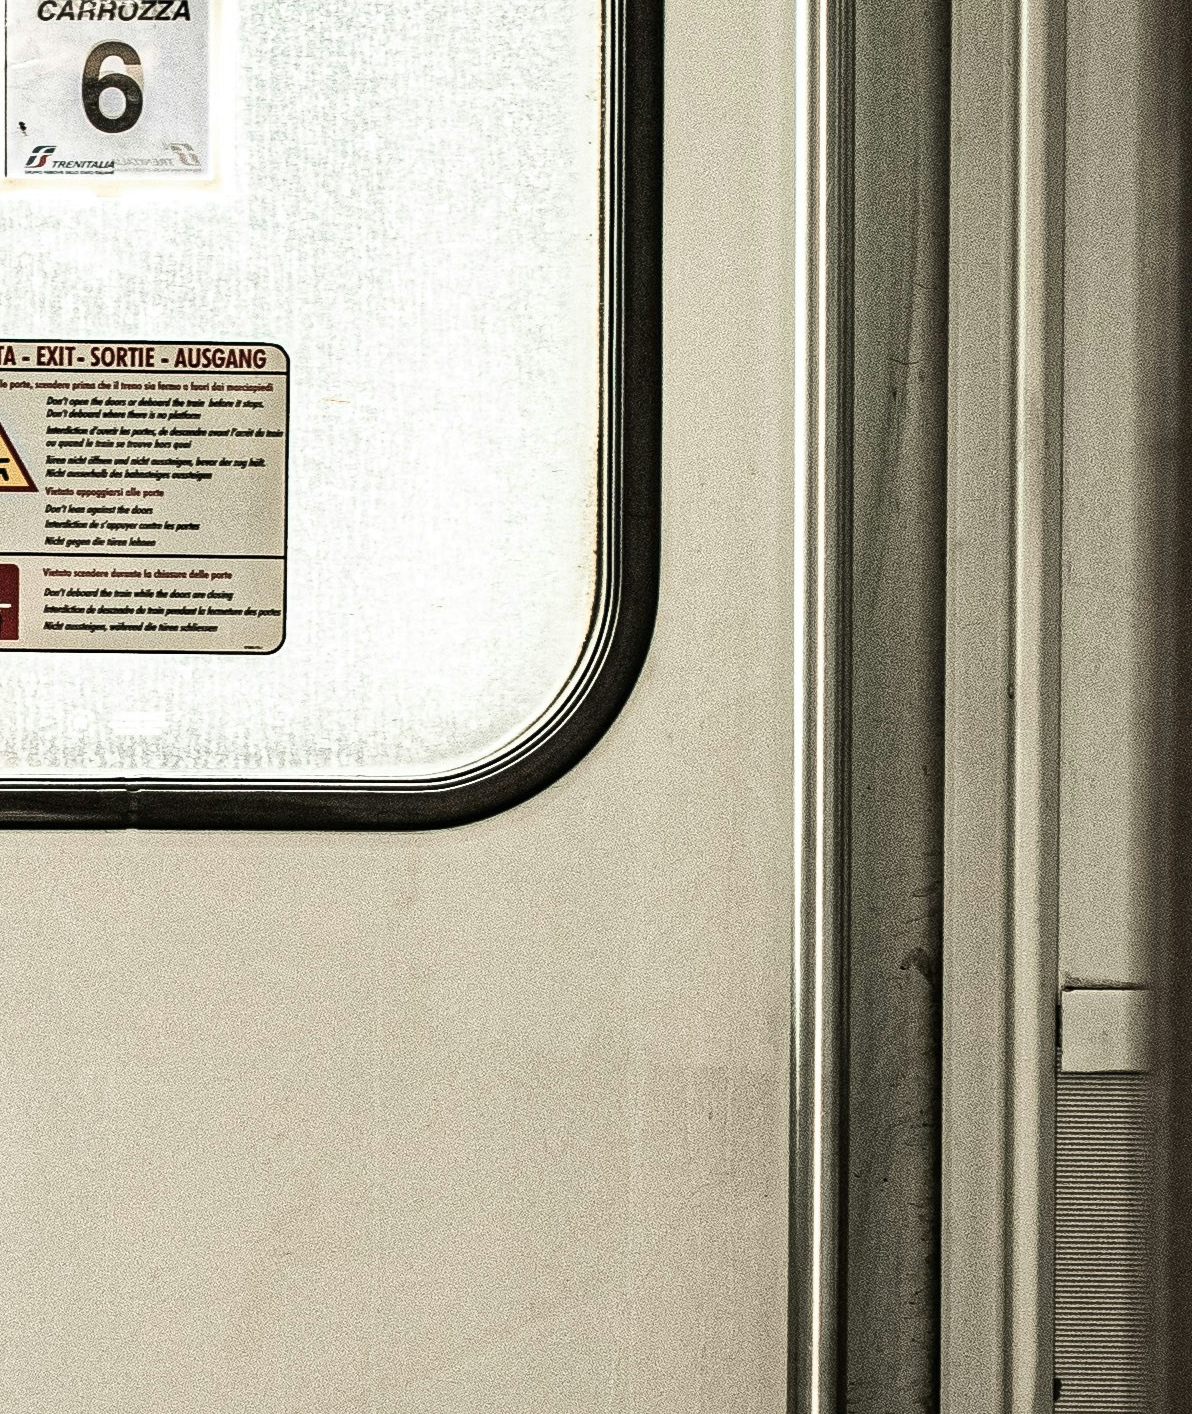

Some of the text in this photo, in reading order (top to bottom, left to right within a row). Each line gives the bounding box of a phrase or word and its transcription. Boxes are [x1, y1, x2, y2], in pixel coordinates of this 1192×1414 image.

[37, 0, 191, 21] CARROZZA
[81, 40, 144, 134] 6
[51, 160, 116, 169] TRENITALIA
[90, 346, 156, 367] SORTIE
[173, 348, 267, 368] AUSGANG
